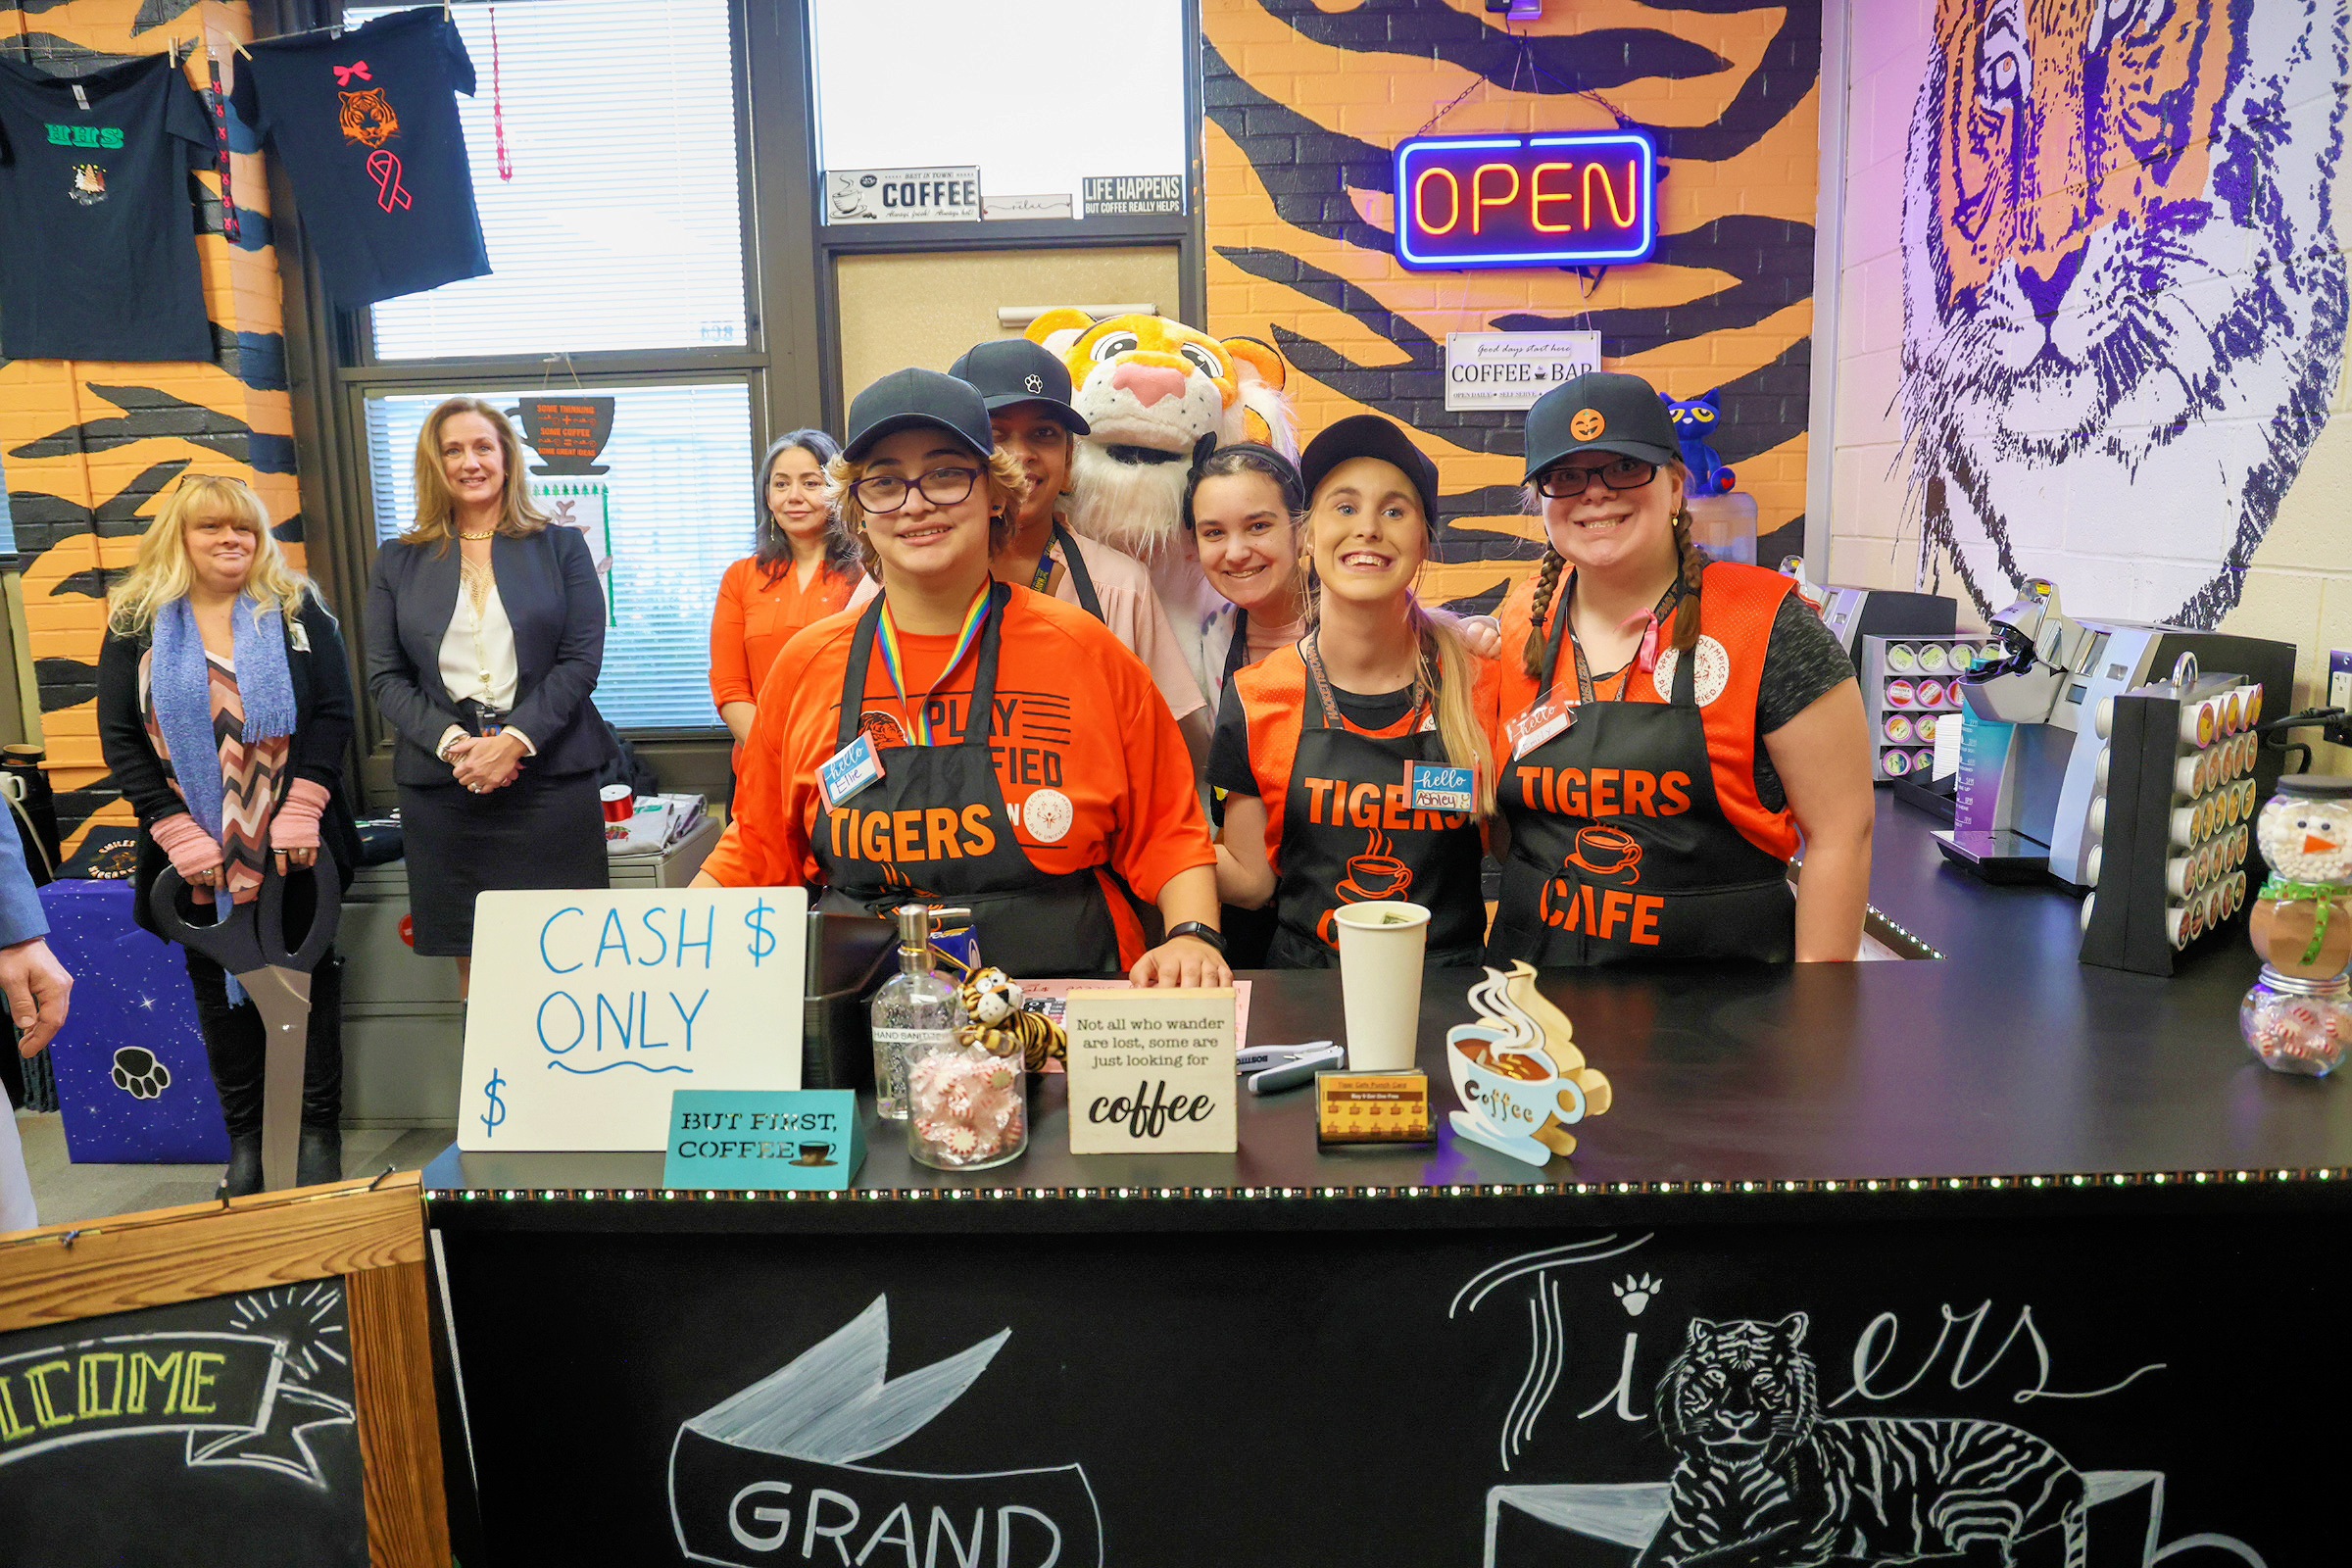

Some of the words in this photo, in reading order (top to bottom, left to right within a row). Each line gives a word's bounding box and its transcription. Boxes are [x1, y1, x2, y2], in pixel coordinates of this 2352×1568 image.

[44, 123, 124, 149] HHS
[882, 179, 977, 208] COFFEE
[1085, 178, 1113, 200] LIFE
[1116, 176, 1180, 200] HAPPENS
[1415, 160, 1636, 235] OPEN
[1085, 203, 1100, 214] BUT
[1101, 202, 1128, 213] COFFEE
[1129, 201, 1155, 213] REALLY
[1155, 200, 1180, 212] HELPS
[1477, 344, 1499, 357] Good
[1502, 344, 1524, 358] days
[1525, 344, 1547, 353] start
[1550, 344, 1571, 353] here
[1451, 364, 1531, 382] COFFEE
[1551, 363, 1592, 381] BAR
[536, 404, 559, 414] SOME
[560, 405, 596, 415] THINKING
[540, 427, 562, 436] SOME
[562, 428, 591, 438] COFFEE
[1696, 638, 1726, 679] OLYMPICS
[825, 746, 863, 780] hello
[835, 769, 862, 794] Ellie
[1413, 769, 1466, 788] hello
[1416, 793, 1456, 808] Ashley
[1516, 765, 1691, 818] TIGERS
[828, 804, 997, 862] TIGERS
[98, 839, 137, 854] SMILES
[1540, 878, 1664, 946] CAFE
[540, 905, 714, 974] CASH
[744, 897, 776, 967] $
[537, 988, 710, 1054] ONLY
[1077, 1019, 1103, 1031] Not
[1106, 1018, 1126, 1030] all
[1130, 1018, 1162, 1030] who
[1166, 1017, 1225, 1030] wander
[1083, 1040, 1108, 1049] are
[1112, 1037, 1145, 1050] lost,
[1149, 1039, 1189, 1049] some
[1193, 1038, 1218, 1048] are
[1092, 1055, 1123, 1069] just
[1127, 1054, 1183, 1068] looking
[1187, 1054, 1208, 1066] for
[1237, 1054, 1268, 1065] BOSTITC
[480, 1067, 507, 1138] $
[1089, 1080, 1216, 1138] coffee
[1464, 1079, 1534, 1123] Coffee
[681, 1112, 742, 1132] BUT
[750, 1112, 838, 1134] FIRST,
[678, 1141, 795, 1159] COFFEE
[729, 1481, 1061, 1568] GRAND
